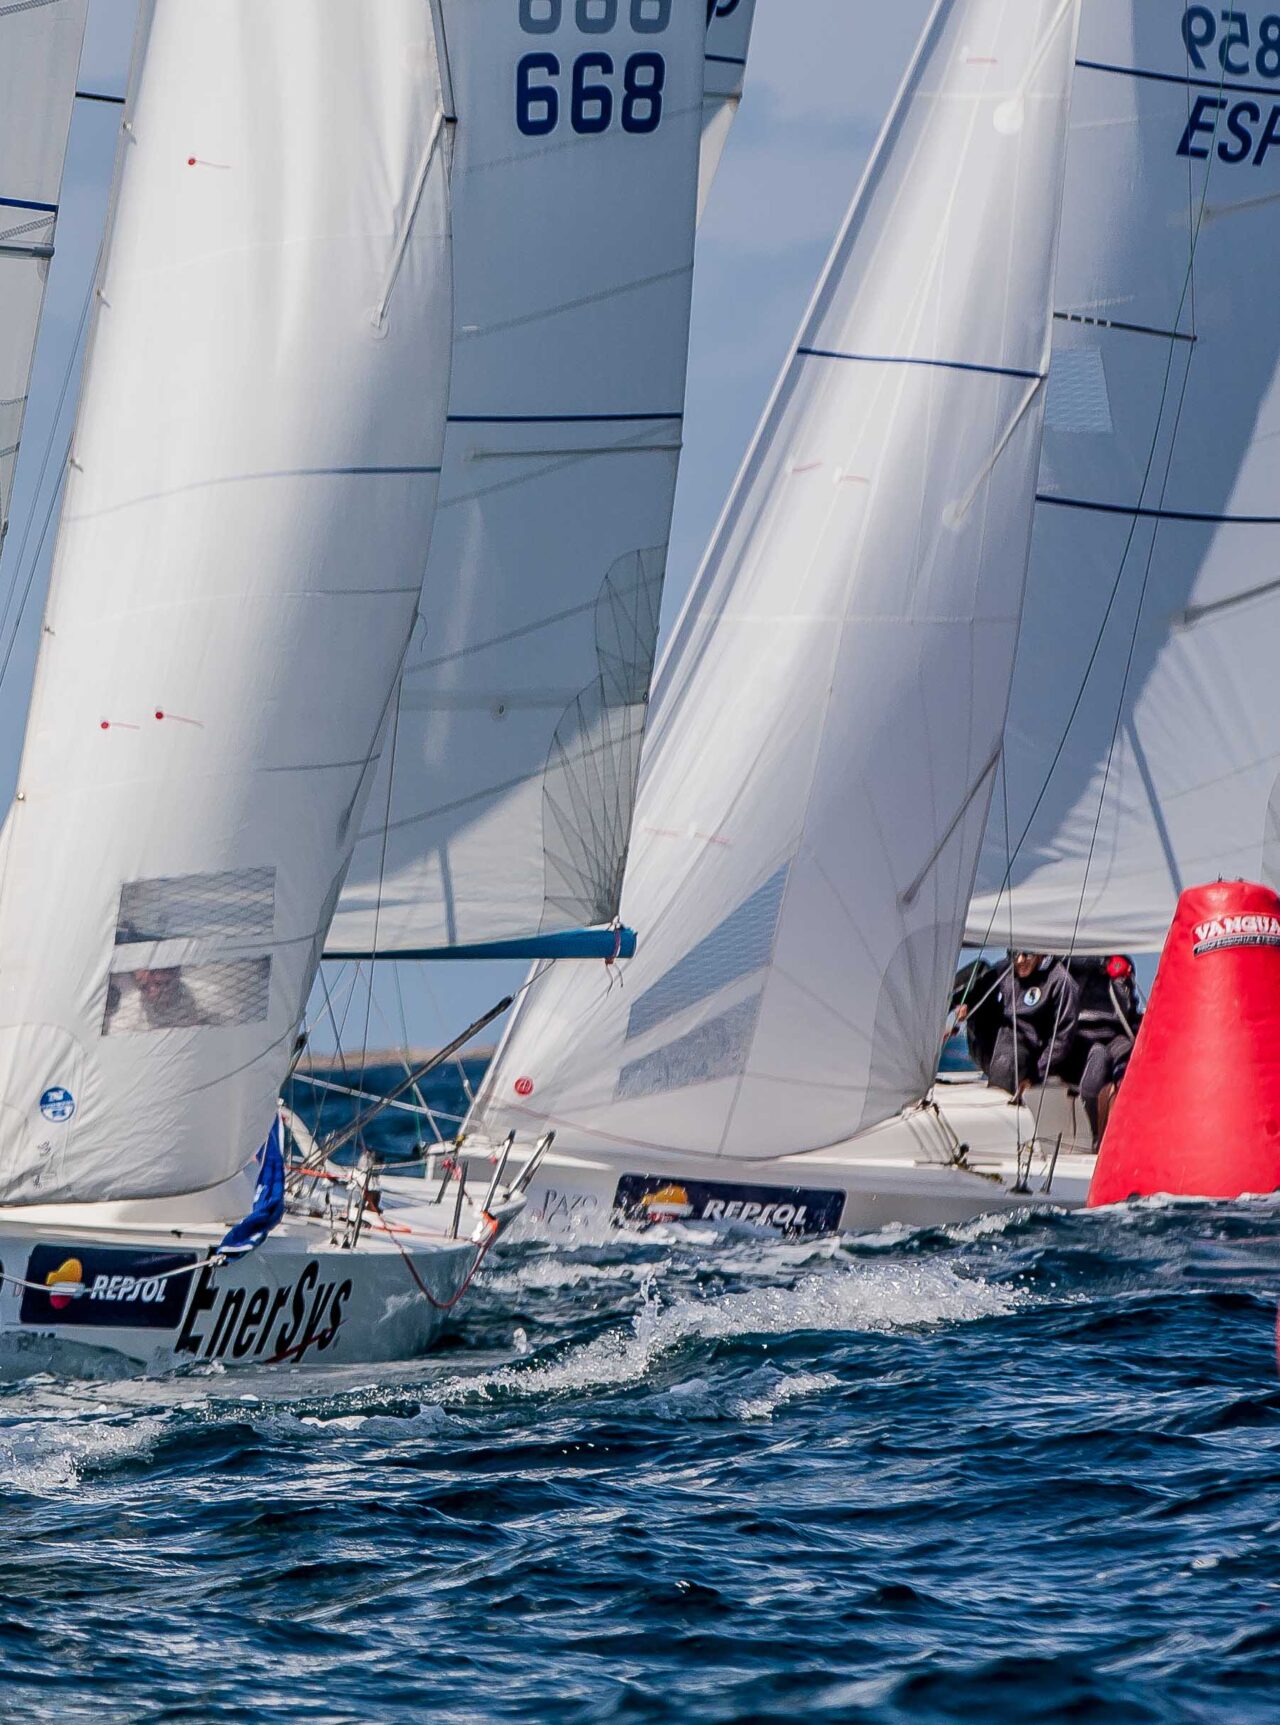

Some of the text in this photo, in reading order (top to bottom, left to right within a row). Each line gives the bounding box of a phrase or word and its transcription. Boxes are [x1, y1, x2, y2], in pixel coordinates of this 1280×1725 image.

[516, 51, 665, 135] 668
[702, 1199, 808, 1227] REPSOL
[89, 1274, 168, 1302] REPSOL
[174, 1245, 354, 1363] EnerSys
